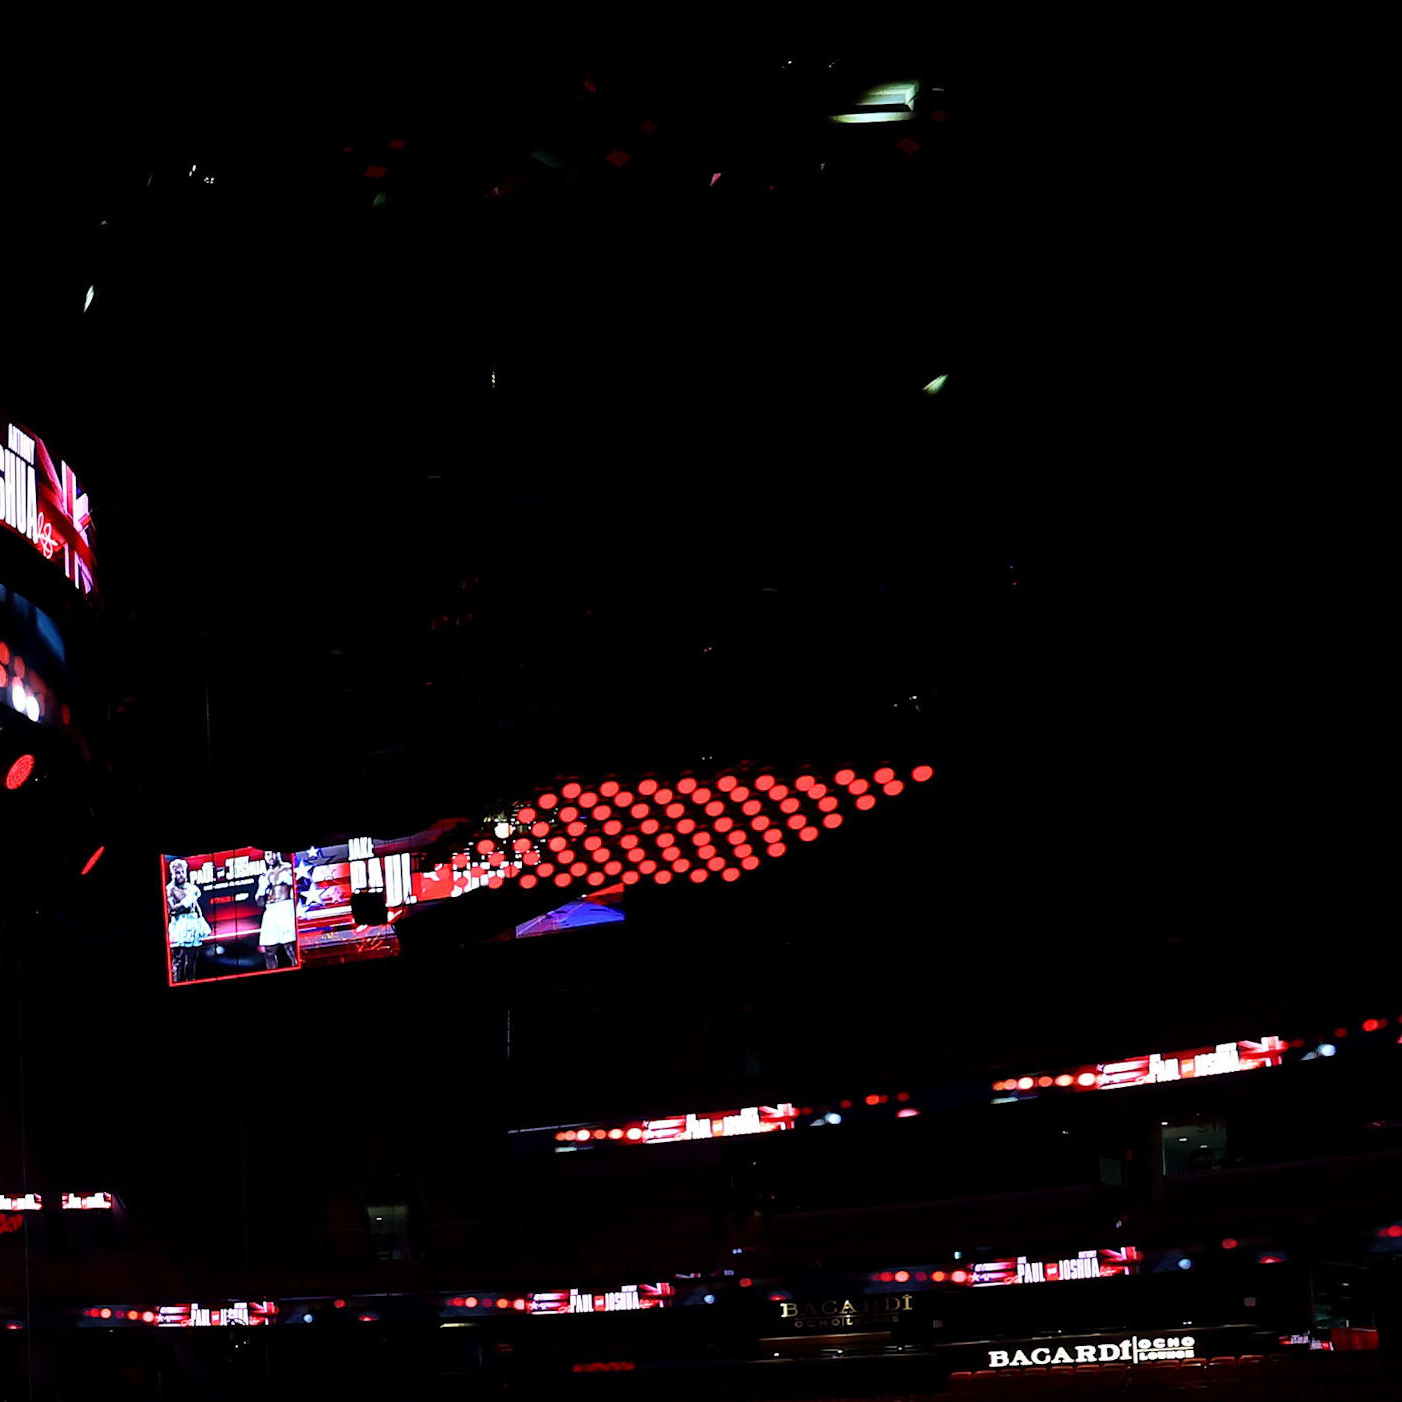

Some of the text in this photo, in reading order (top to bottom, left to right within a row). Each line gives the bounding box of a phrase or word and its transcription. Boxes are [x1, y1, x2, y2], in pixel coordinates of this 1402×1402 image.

[348, 837, 374, 861] JAKE
[1017, 1258, 1101, 1284] PAUL JOSHUA
[569, 1291, 640, 1313] PAUL JOSHUA
[1137, 1336, 1195, 1349] OCHO
